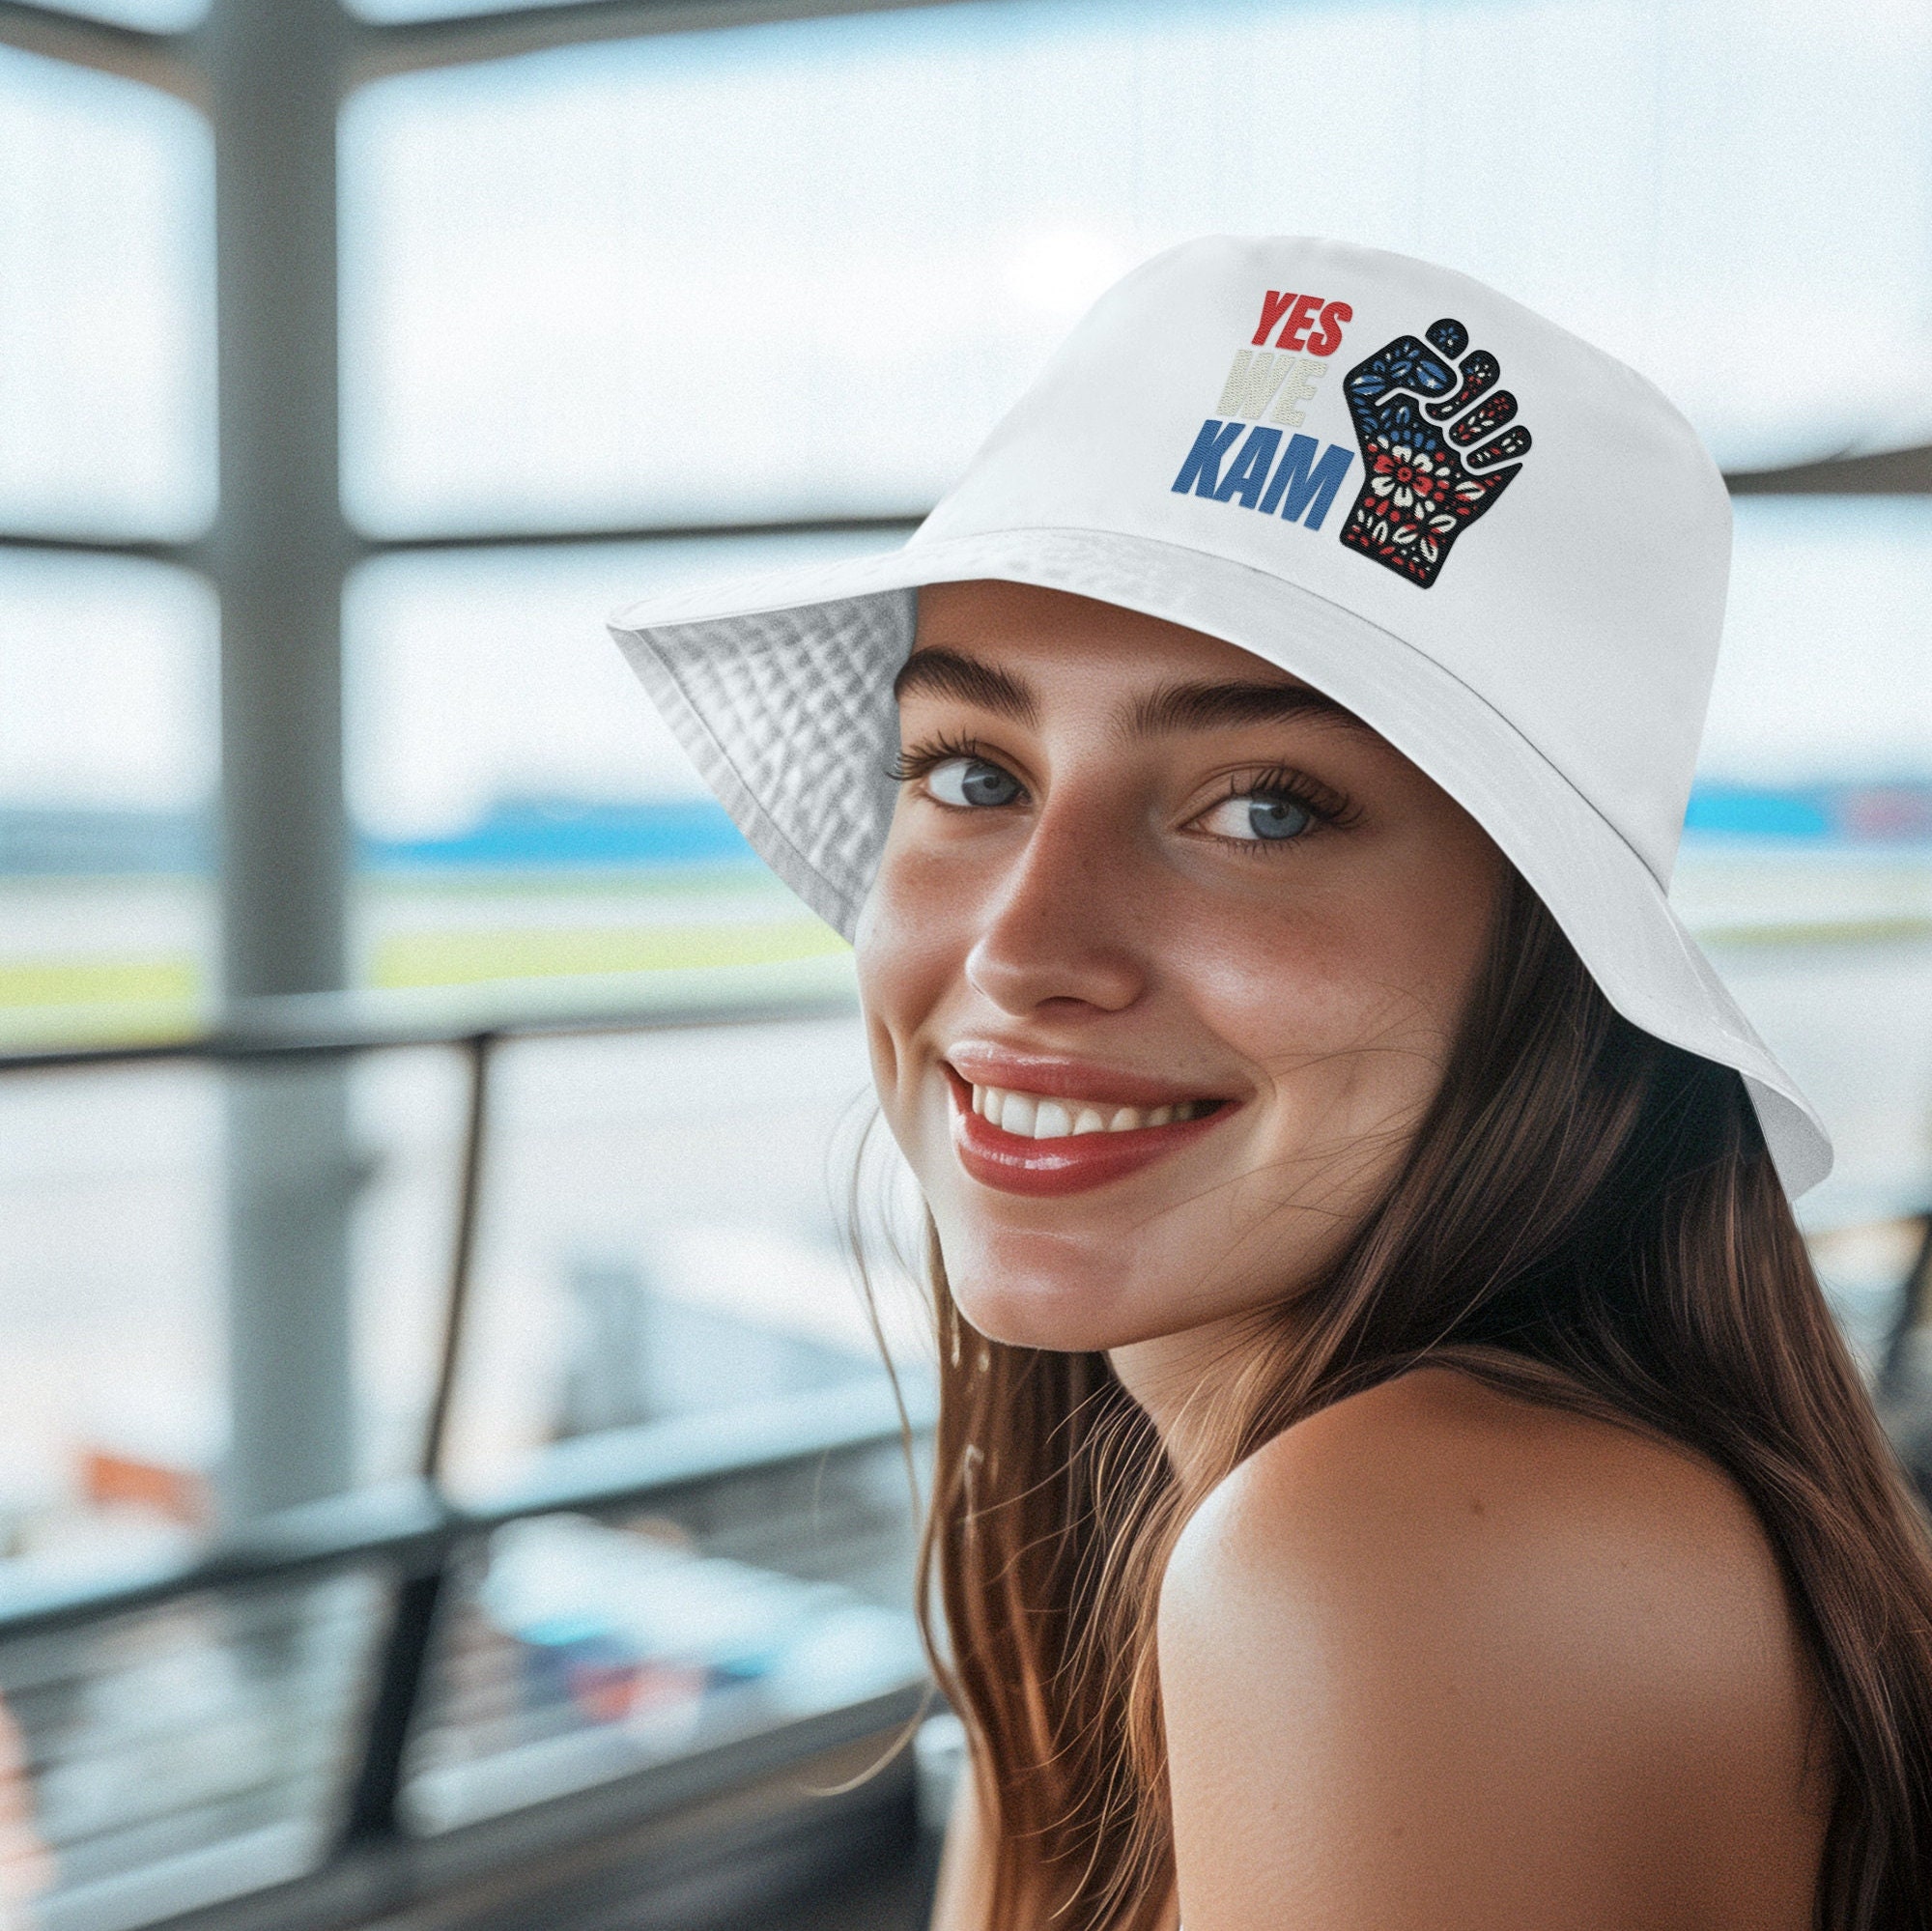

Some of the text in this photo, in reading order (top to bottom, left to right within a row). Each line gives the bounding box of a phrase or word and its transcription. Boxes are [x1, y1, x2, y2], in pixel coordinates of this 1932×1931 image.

[1251, 290, 1353, 357] YES
[1214, 349, 1329, 428] WE
[1170, 418, 1355, 532] KAM
